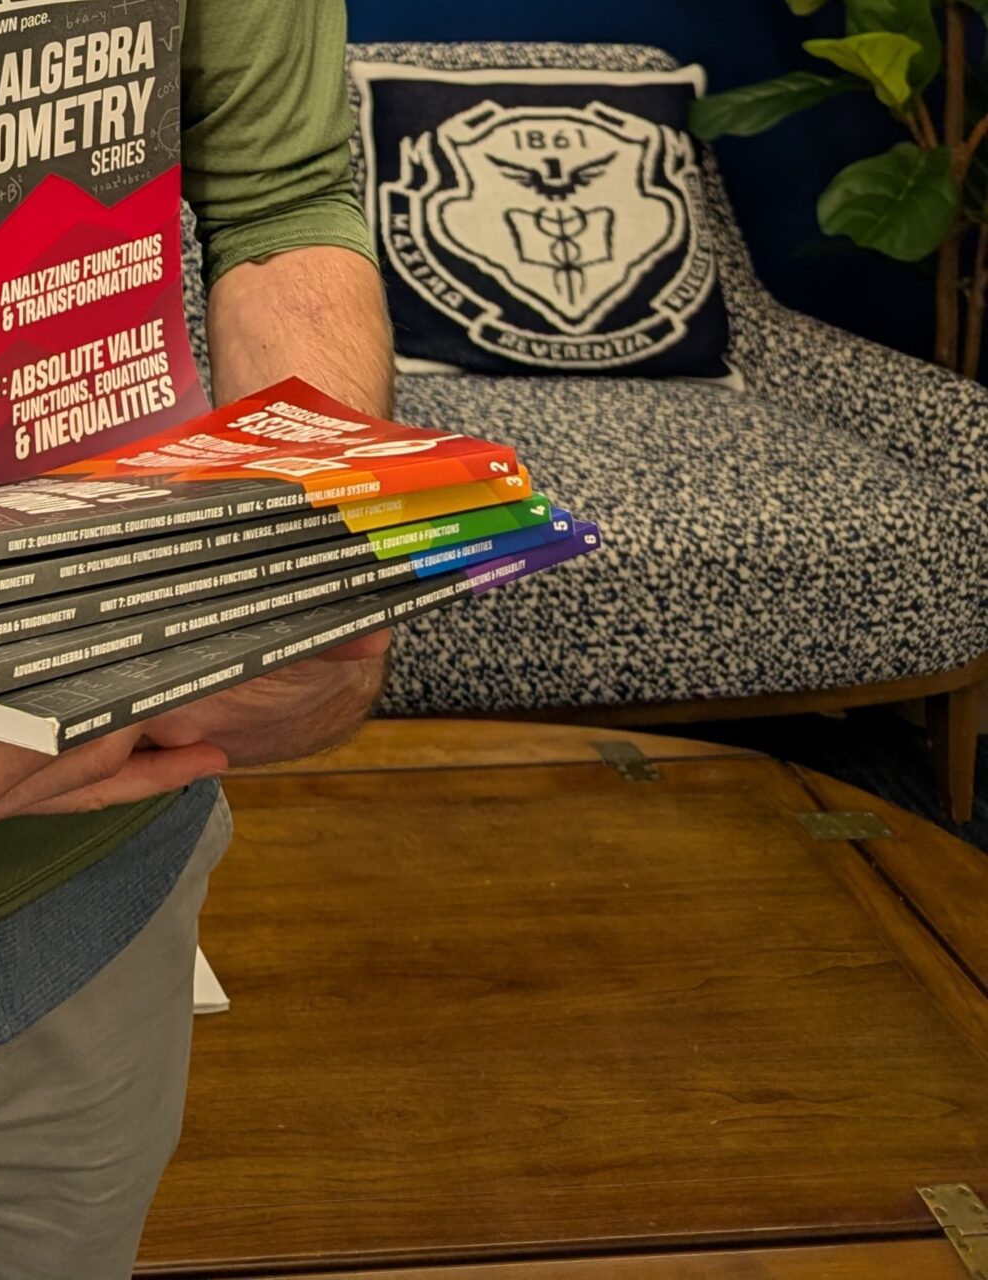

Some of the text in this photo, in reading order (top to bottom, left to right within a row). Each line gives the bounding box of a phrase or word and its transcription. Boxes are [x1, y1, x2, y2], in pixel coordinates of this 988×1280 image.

[20, 12, 51, 32] pace.
[91, 138, 146, 176] SERIES
[511, 128, 590, 151] 1861
[0, 259, 80, 306] ANALYZING
[83, 233, 163, 278] FUNCTIONS
[2, 257, 163, 332] & TRANSFORMATIONS
[390, 213, 464, 311] MAXIMA
[10, 339, 104, 400] ABSOLUTE
[107, 318, 165, 364] VALUE
[498, 331, 653, 360] REVERENTIA
[12, 351, 169, 426] FUNCTIONS, EQUATIONS
[15, 425, 30, 460] &
[34, 375, 176, 453] INEQUALITIES
[490, 461, 509, 473] 2
[8, 540, 27, 551] UNIT
[36, 532, 79, 547] QUADRATIC
[79, 524, 124, 540] FUNCTIONS,
[125, 516, 166, 534] EQUATIONS
[173, 506, 224, 524] INEQUALITIES
[237, 501, 255, 514] UNIT
[266, 496, 297, 509] CIRCLES
[304, 488, 346, 503] NONLINEAR
[346, 481, 381, 497] SYSTEMS
[60, 566, 78, 578] UNIT
[87, 555, 132, 573] POLYNOMIAL
[132, 545, 173, 563] FUNCTIONS
[180, 539, 203, 552] ROOTS
[215, 533, 232, 547] UNIT
[275, 520, 302, 535] SQUARE
[303, 516, 321, 529] ROOT
[20, 608, 77, 630] TRIGONOMETRY
[100, 601, 118, 613] UNIT
[127, 587, 174, 606] EXPONENTIAL
[175, 578, 213, 596] EQUATIONS
[219, 567, 258, 586] FUNCTIONS
[269, 562, 286, 574] UNIT
[295, 550, 340, 568] LOGARITHMIC
[383, 532, 419, 550] EQUATIONS
[425, 523, 460, 540] FUNCTIONS
[13, 659, 51, 678] ADVANCED
[51, 650, 84, 669] ALGEBRA
[90, 633, 144, 657] TRIGONOMETRY
[165, 624, 182, 637] UNIT
